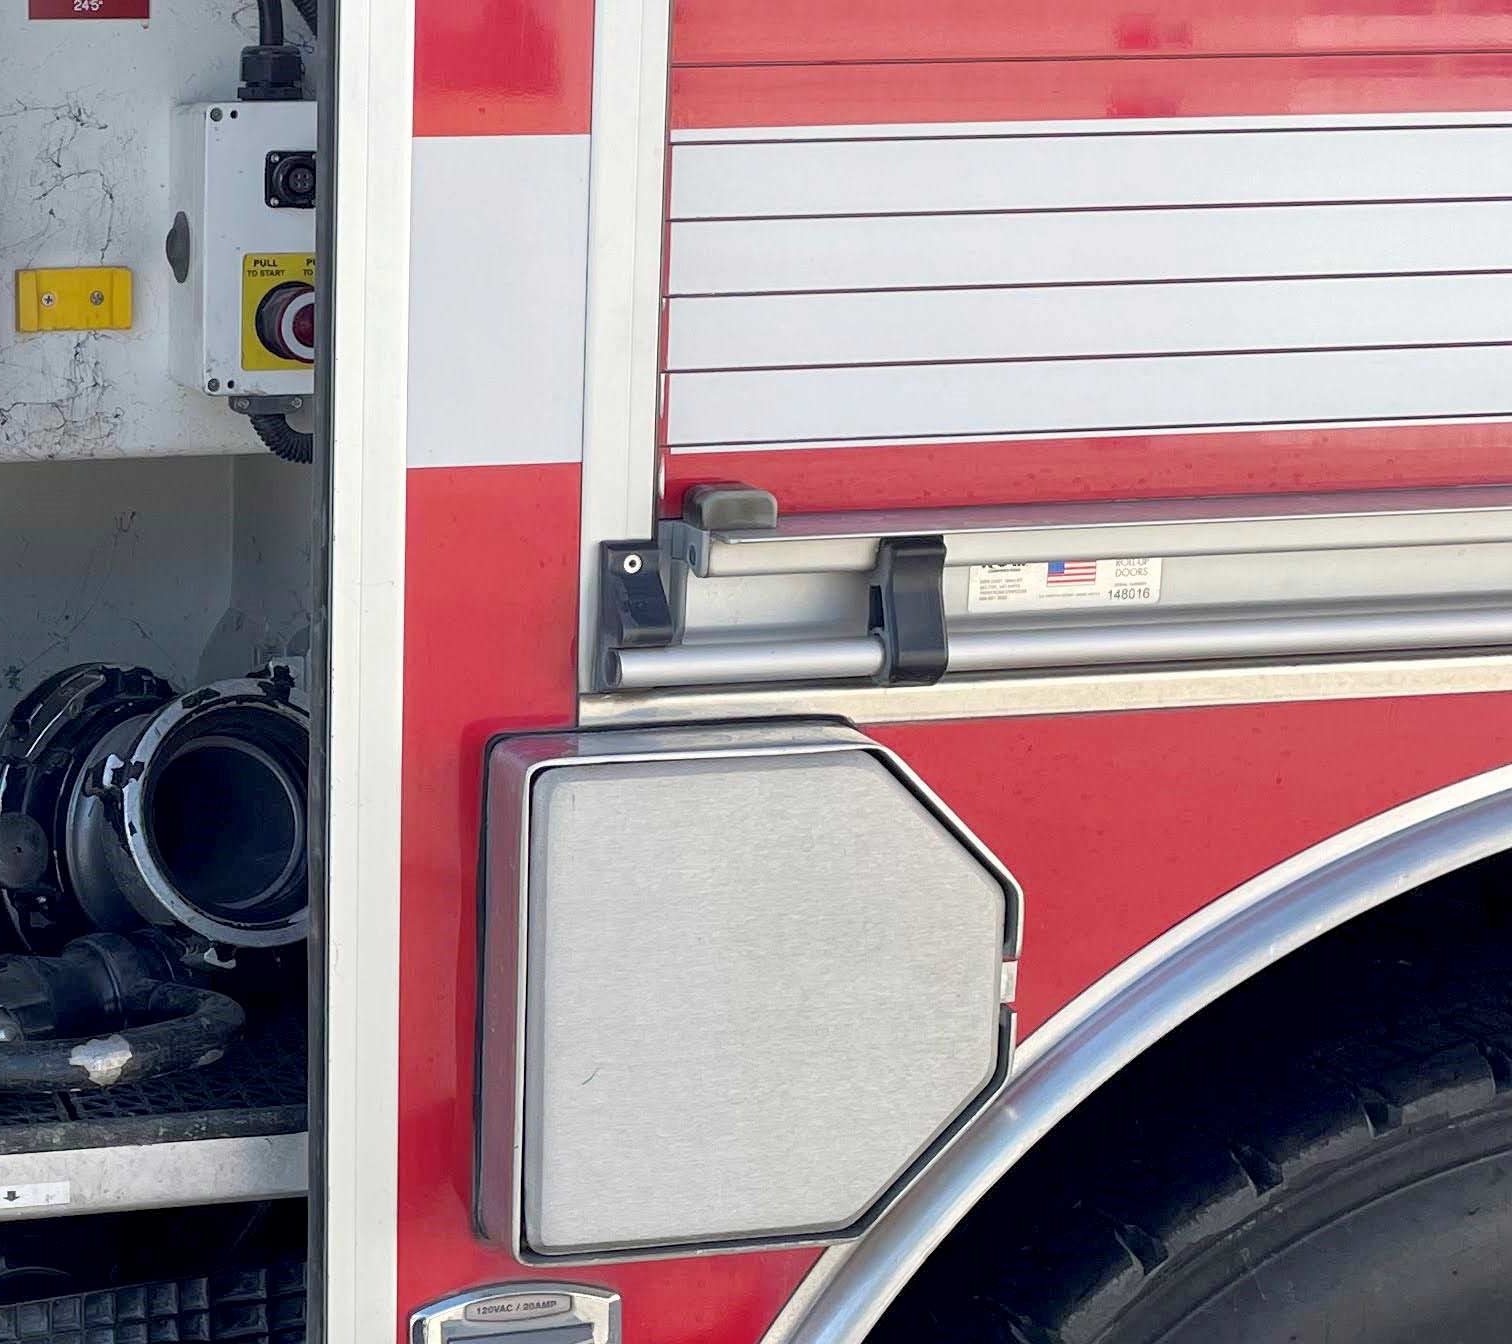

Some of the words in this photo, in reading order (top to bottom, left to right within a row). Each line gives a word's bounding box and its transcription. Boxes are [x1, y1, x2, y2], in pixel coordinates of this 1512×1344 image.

[253, 258, 279, 267] PULL
[247, 269, 258, 277] TO
[260, 269, 286, 277] START
[1108, 587, 1151, 600] 148016
[476, 1303, 513, 1315] 120VAC
